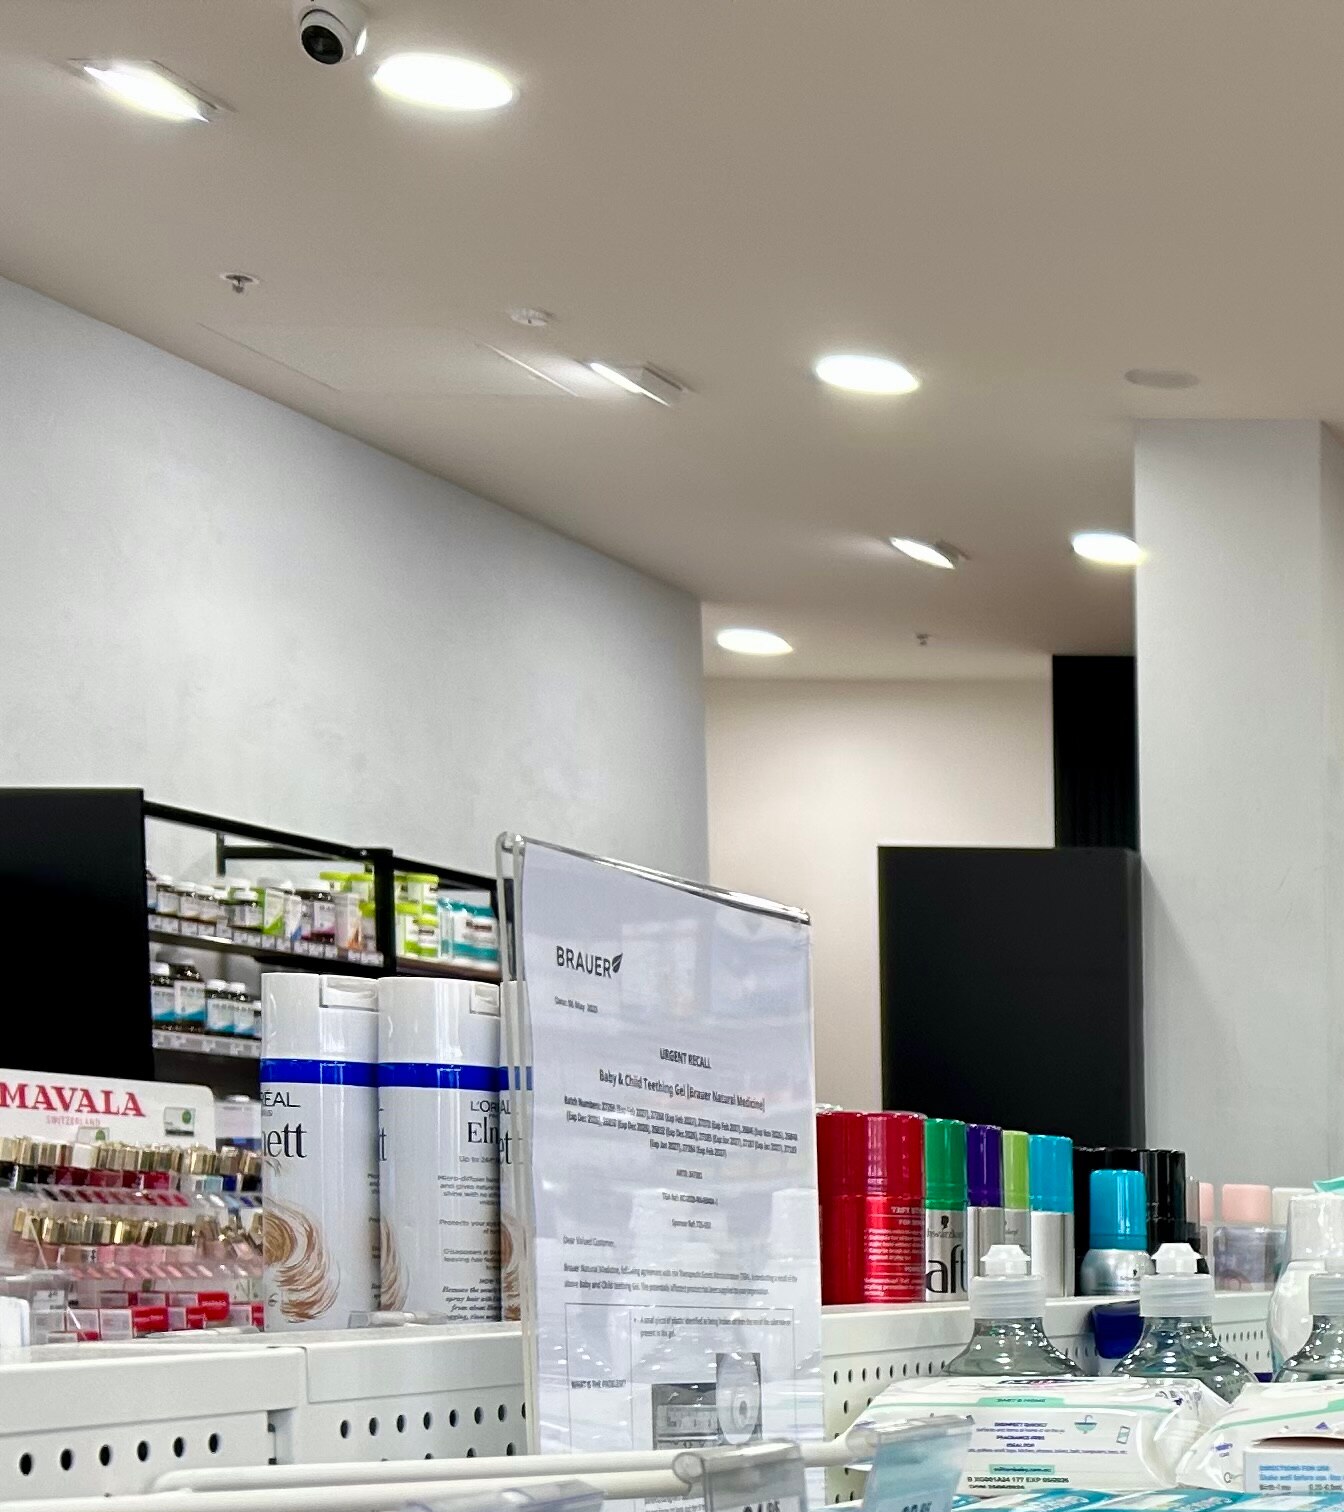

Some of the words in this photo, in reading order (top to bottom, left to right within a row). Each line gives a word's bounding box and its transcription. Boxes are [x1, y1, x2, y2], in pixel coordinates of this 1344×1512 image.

[556, 945, 611, 979] BRAUER
[659, 1048, 686, 1066] URGENT
[688, 1054, 712, 1069] RECALL
[0, 1081, 146, 1117] MAVALA
